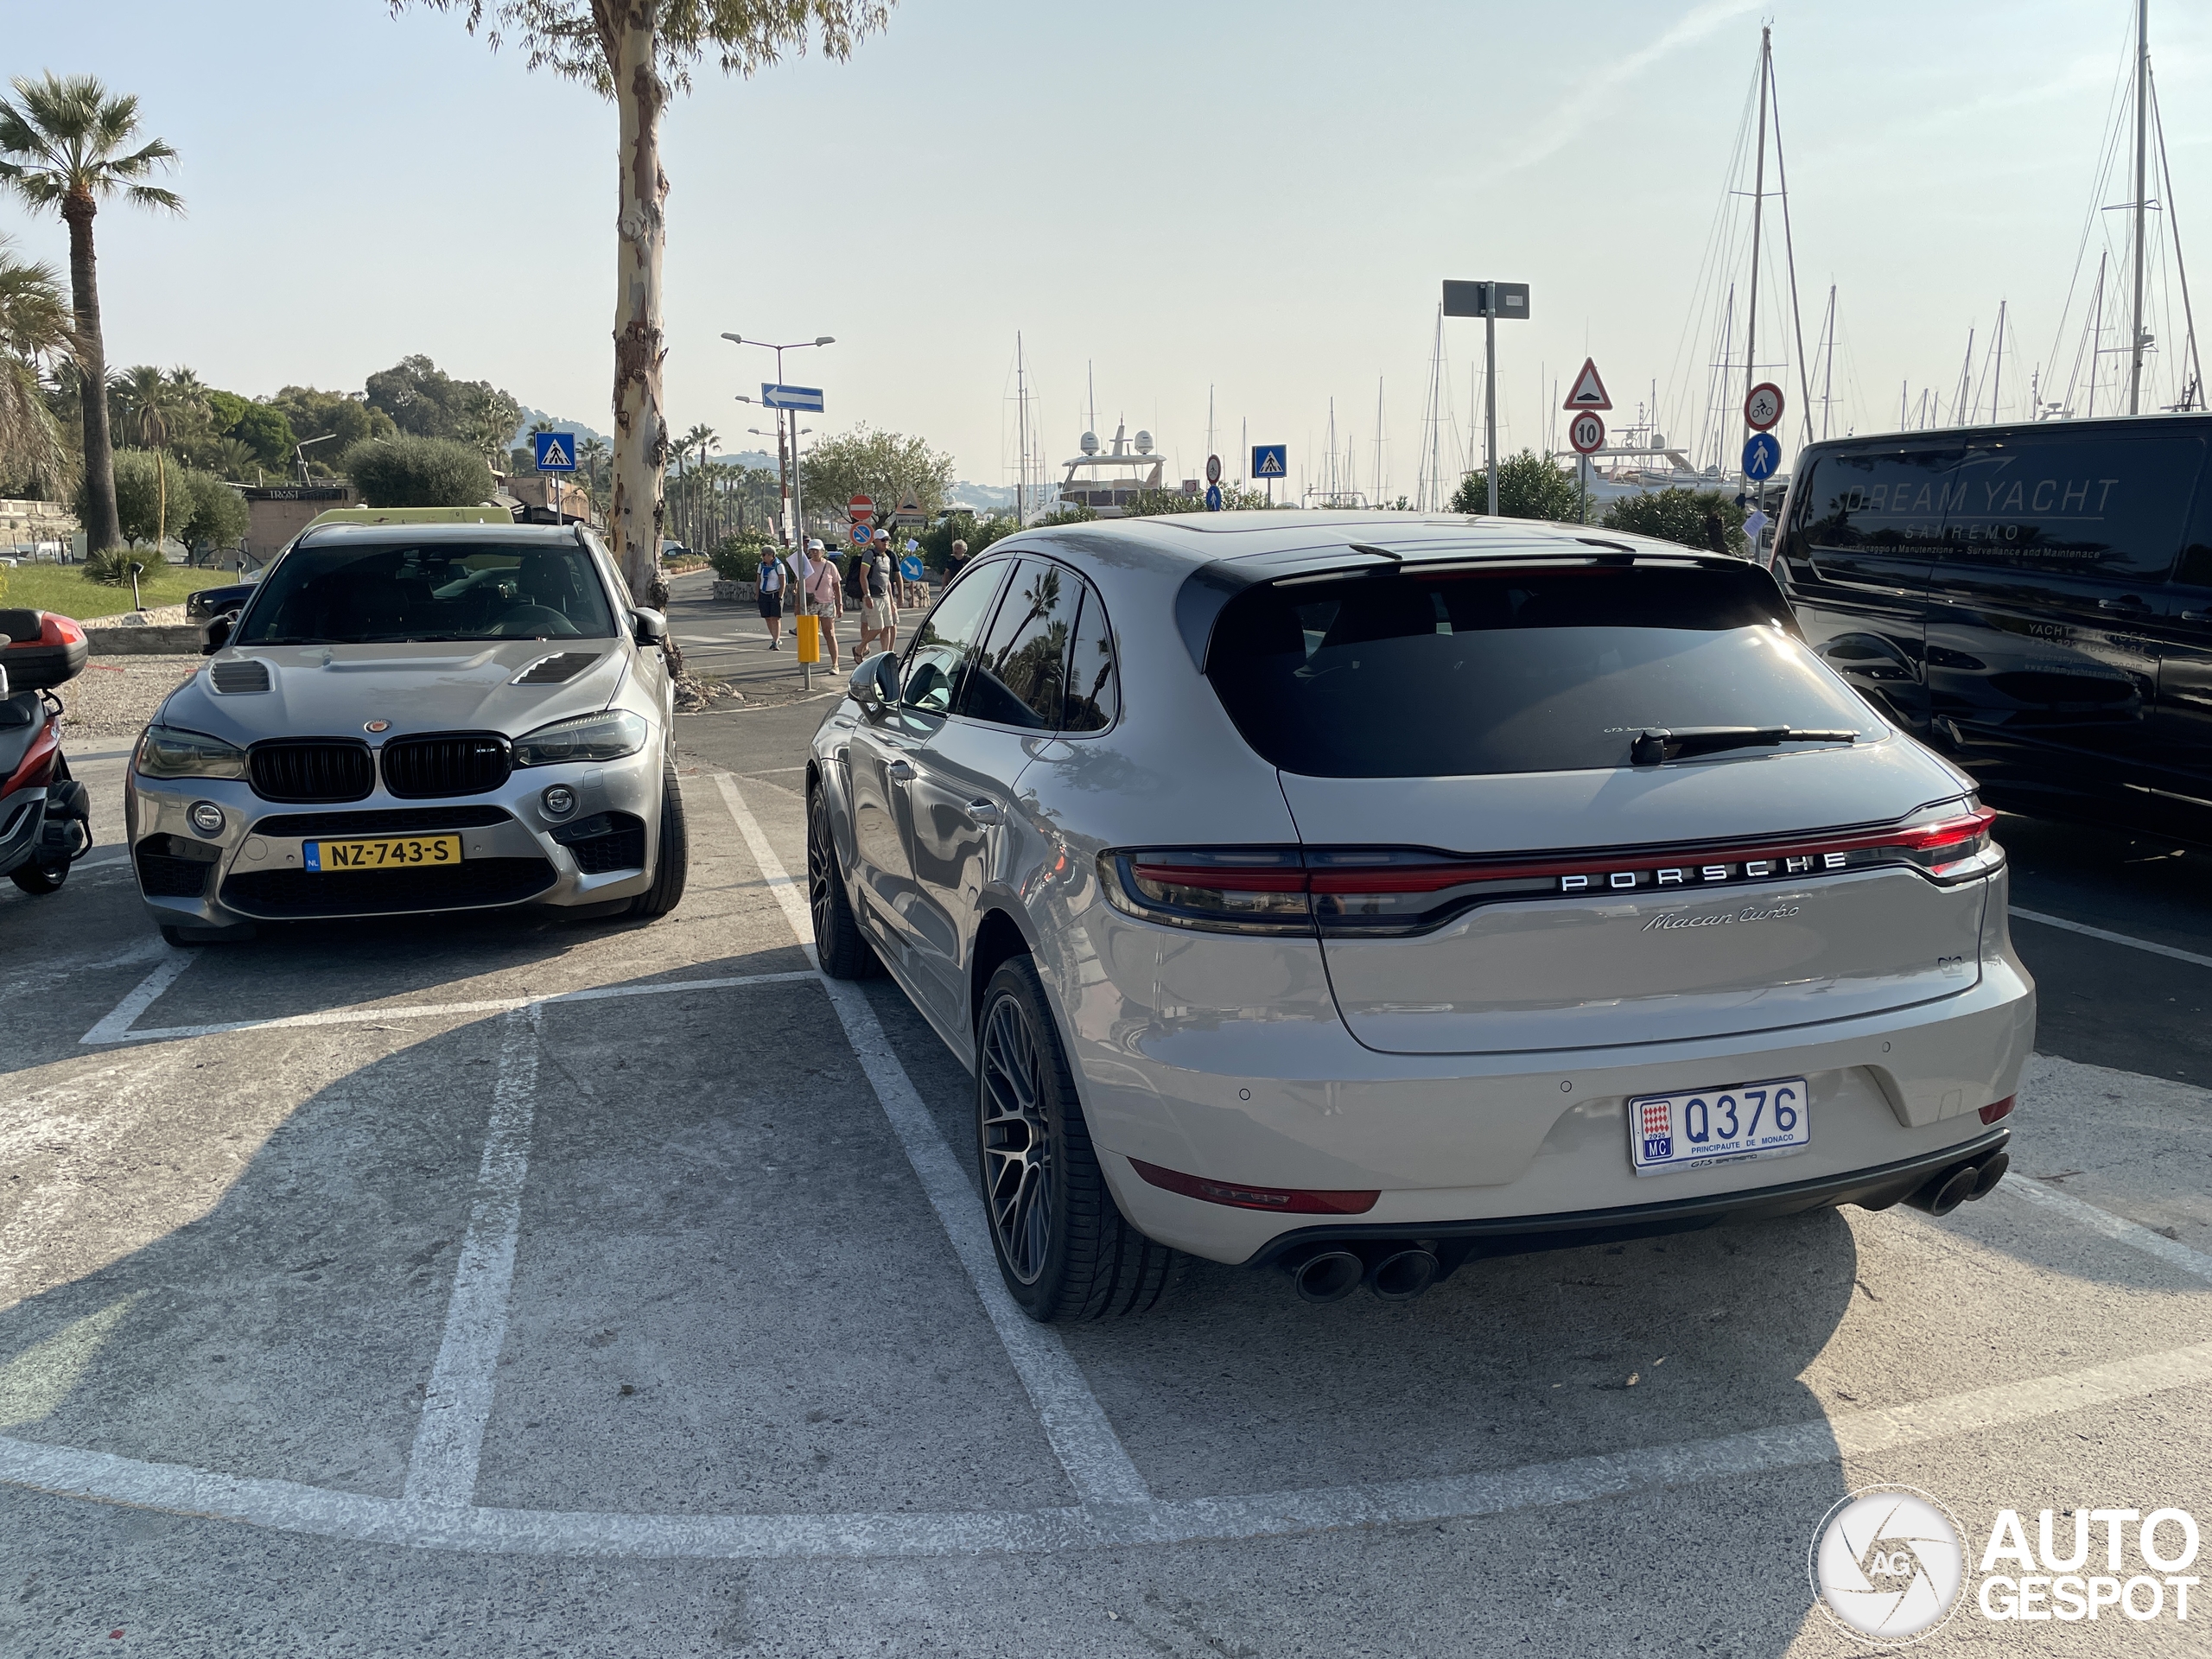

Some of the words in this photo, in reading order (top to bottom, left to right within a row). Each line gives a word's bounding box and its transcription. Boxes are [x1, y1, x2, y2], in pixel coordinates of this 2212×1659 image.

[1579, 423, 1597, 443] 10
[1845, 481, 1968, 512] DREAM
[1985, 479, 2120, 512] YACHT
[1904, 524, 2018, 541] SANREMO
[1898, 543, 1954, 554] Manutenzione
[2022, 547, 2041, 557] and
[2029, 623, 2073, 637] YACHT
[2076, 628, 2148, 644] SERVICES
[332, 840, 448, 867] NZ-743-S
[1561, 851, 1847, 891] PORSCHE
[1642, 912, 1732, 931] Macan
[1685, 1087, 1797, 1144] Q376
[1649, 1140, 1667, 1157] MC
[1691, 1141, 1740, 1154] PRINCIPAUTE
[1761, 1134, 1794, 1145] MONACO
[1690, 1158, 1713, 1167] GTS
